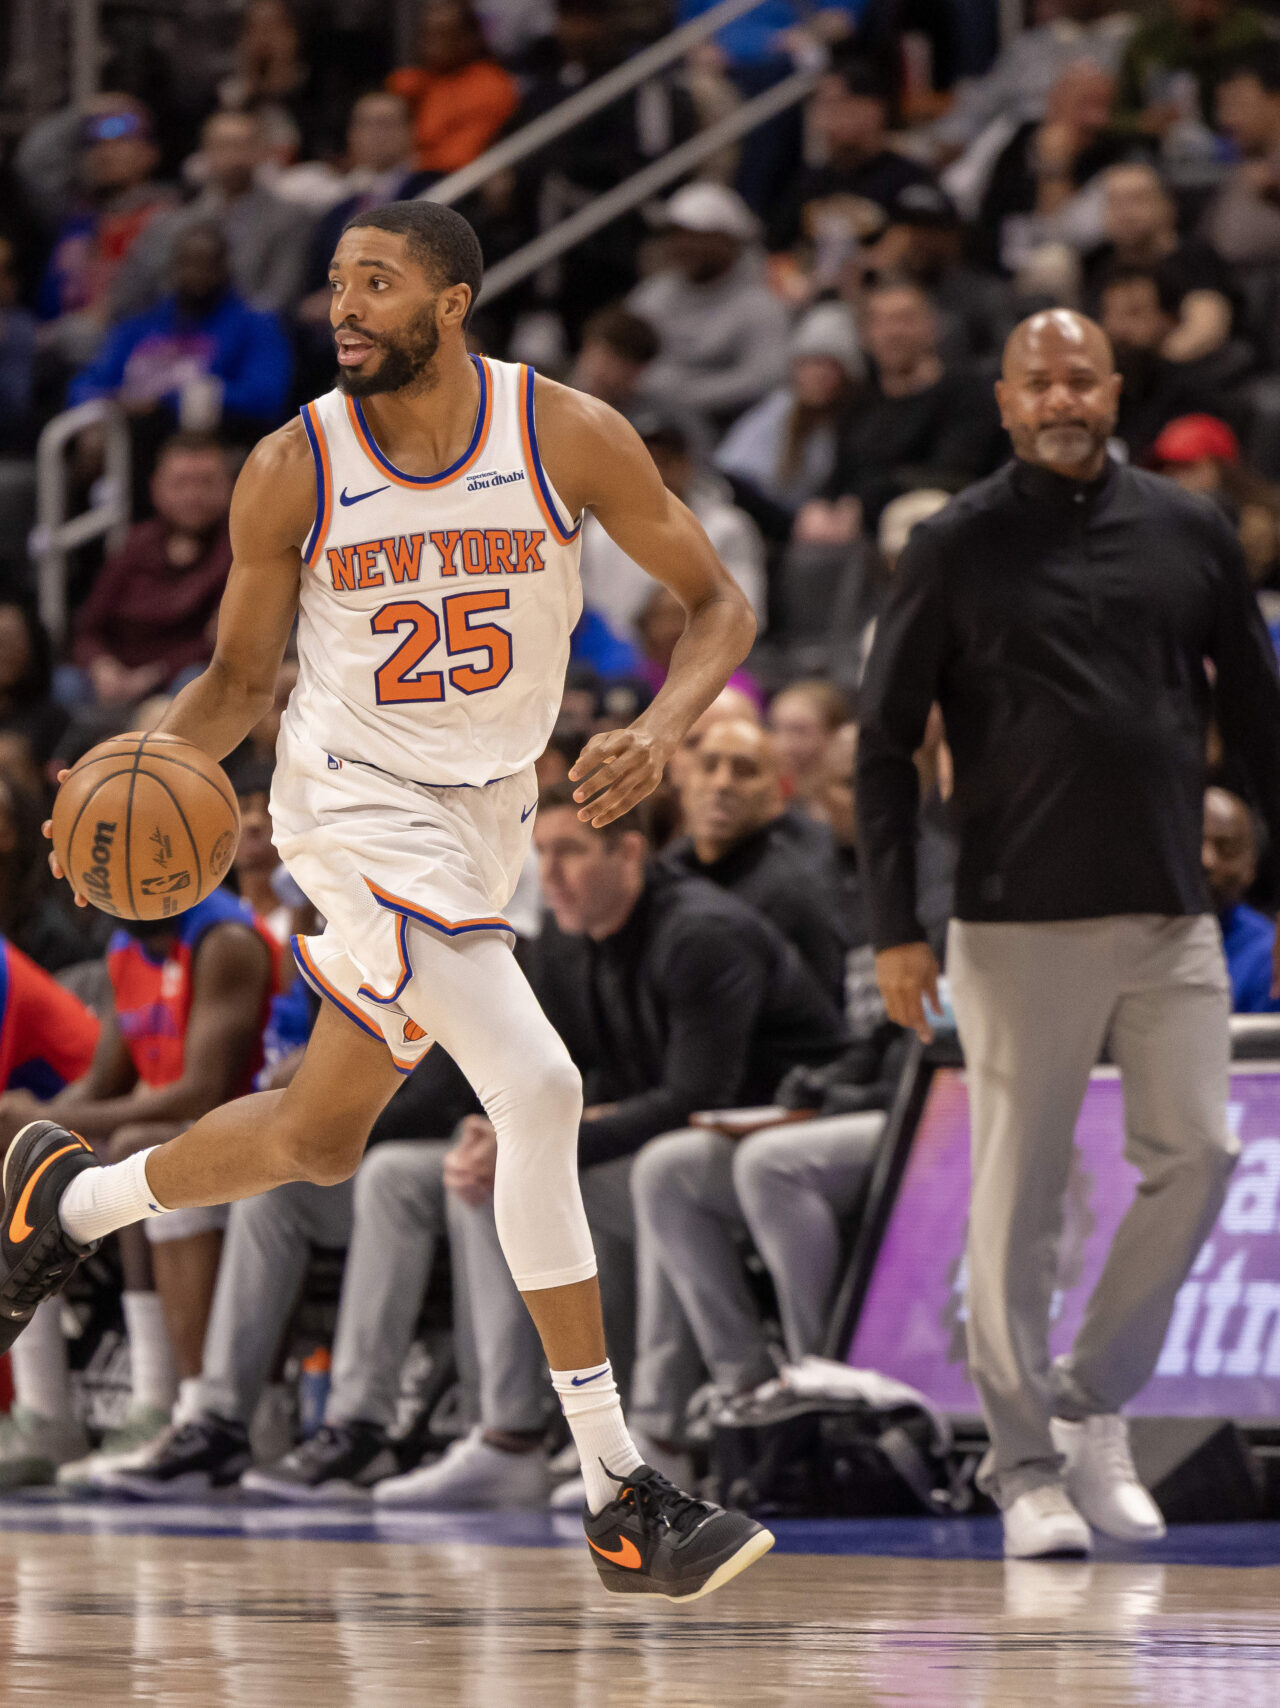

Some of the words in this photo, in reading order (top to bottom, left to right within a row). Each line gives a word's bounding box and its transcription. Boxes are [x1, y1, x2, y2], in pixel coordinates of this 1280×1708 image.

[466, 470, 497, 481] experience
[467, 480, 490, 491] abu
[491, 469, 525, 487] dhabi
[327, 533, 425, 591] NEW
[429, 528, 547, 577] YORK
[370, 588, 514, 706] 25
